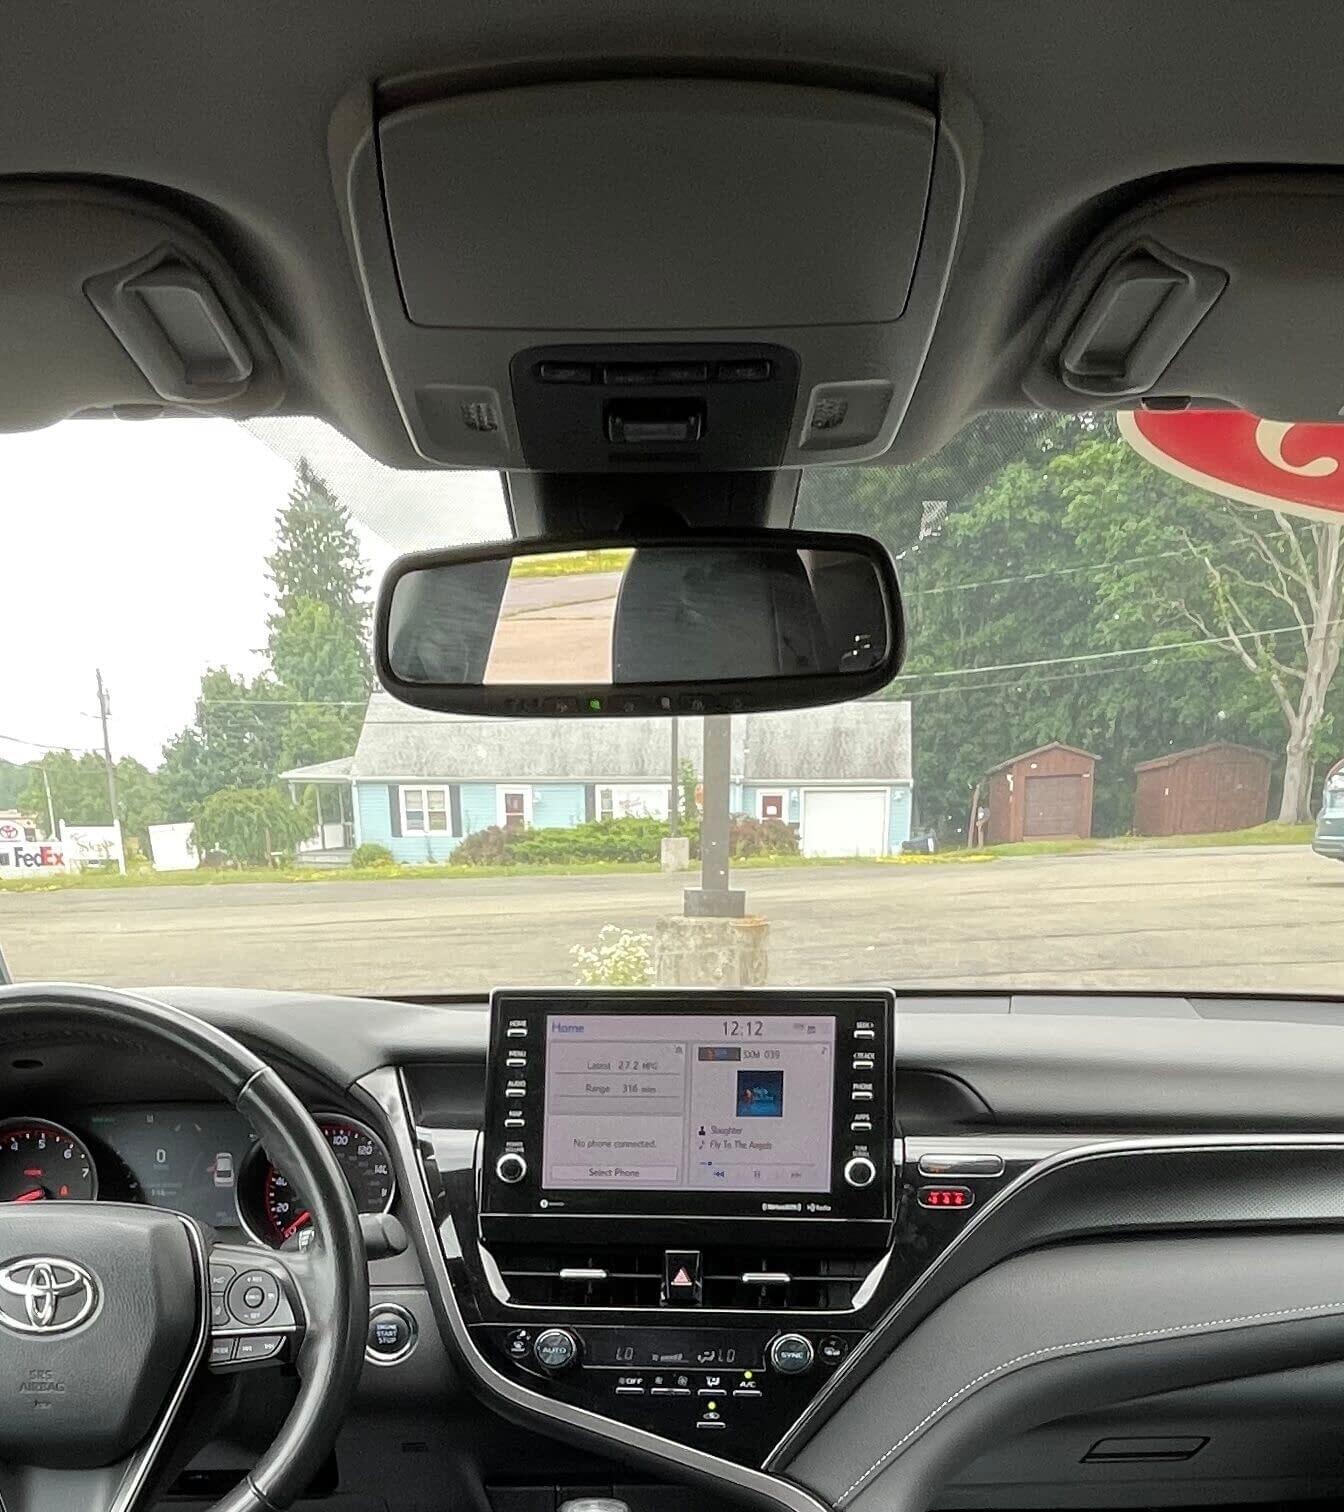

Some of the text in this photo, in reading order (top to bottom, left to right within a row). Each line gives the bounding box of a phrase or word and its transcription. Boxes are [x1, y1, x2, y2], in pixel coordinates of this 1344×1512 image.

[14, 846, 65, 867] FedEx
[551, 1022, 584, 1033] Home
[723, 1021, 763, 1036] 12:12
[585, 1083, 610, 1094] Range
[38, 1140, 46, 1149] 5
[333, 1136, 348, 1145] 100
[574, 1139, 585, 1148] No
[587, 1139, 611, 1149] phone
[710, 1140, 720, 1149] Fly
[723, 1140, 732, 1149] To
[735, 1140, 747, 1149] The
[11, 1141, 18, 1151] 4
[63, 1149, 72, 1159] 6
[156, 1148, 166, 1163] 0
[82, 1168, 89, 1178] 7
[589, 1168, 639, 1177] Select Phone
[276, 1203, 289, 1213] 20
[616, 1347, 634, 1361] LO
[19, 1381, 65, 1392] AIRBAG
